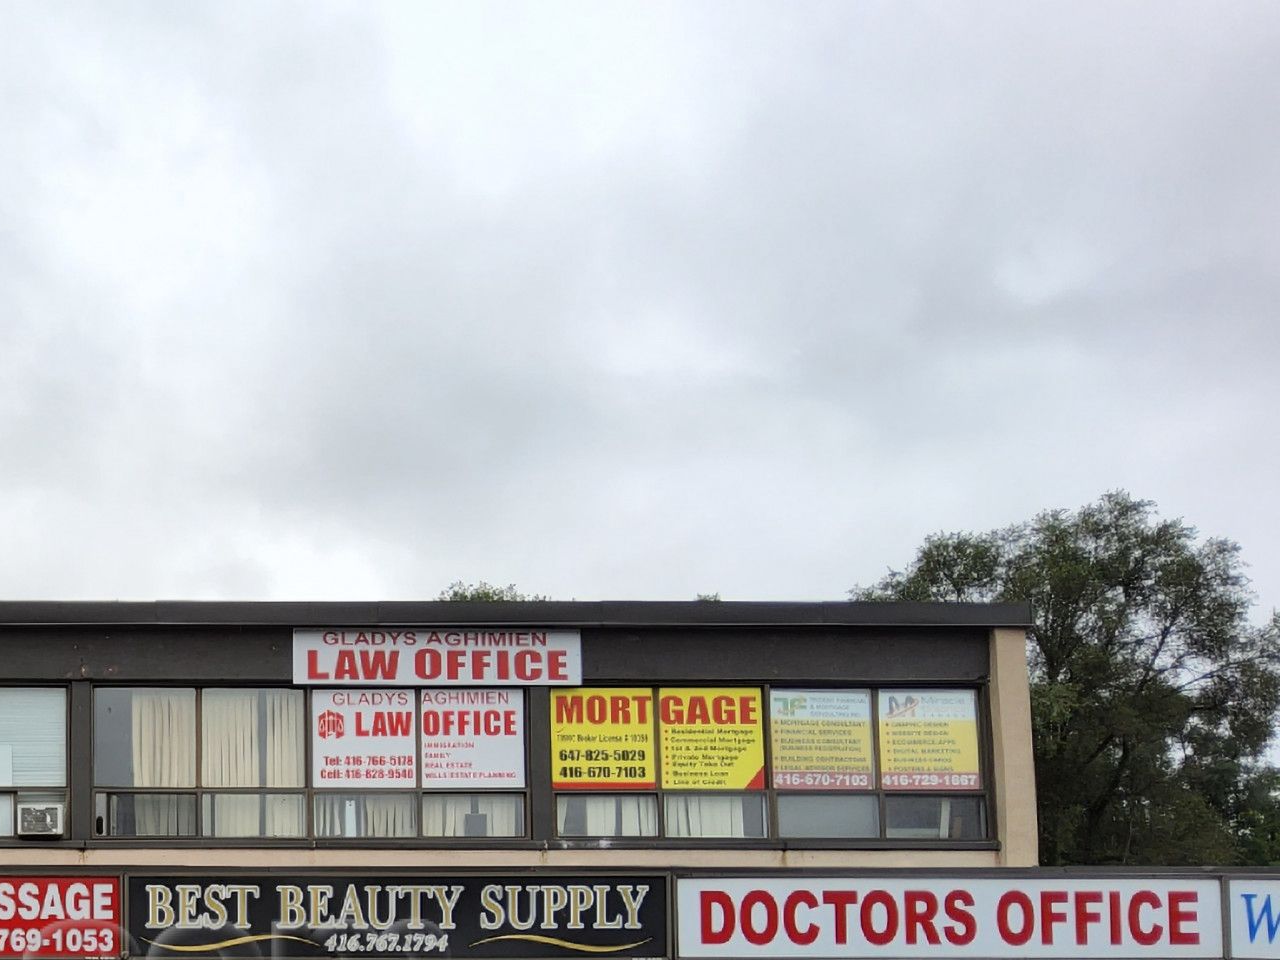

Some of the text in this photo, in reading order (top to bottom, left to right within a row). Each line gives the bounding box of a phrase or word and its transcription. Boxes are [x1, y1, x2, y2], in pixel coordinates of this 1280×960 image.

[322, 631, 548, 647] GLADYS AGHIMIEN
[307, 648, 569, 682] LAW OFFICE
[331, 691, 409, 707] GLADYS
[421, 691, 509, 706] AGHIMIEN
[555, 695, 652, 725] MORT
[659, 695, 758, 725] GAGE
[354, 711, 412, 737] LAW
[422, 709, 517, 737] OFFICE
[323, 755, 343, 767] Tel:
[558, 766, 648, 780] 416-670-7103
[774, 773, 869, 787] 416-670-7103
[144, 883, 651, 931] BEST BEAUTY SUPPLY
[698, 888, 1201, 946] DOCTORS OFFICE
[324, 932, 449, 954] 416.767.1794
